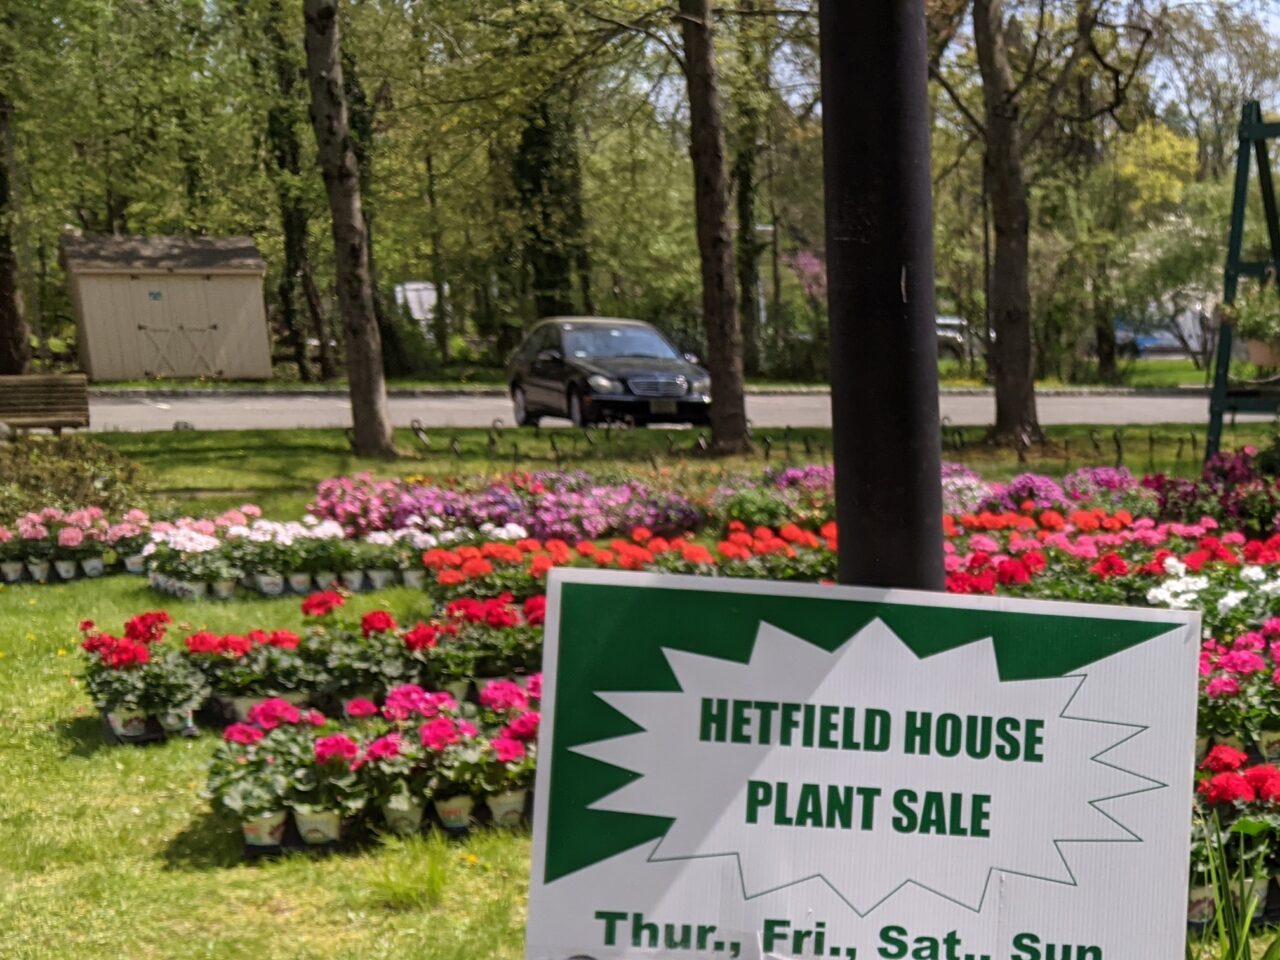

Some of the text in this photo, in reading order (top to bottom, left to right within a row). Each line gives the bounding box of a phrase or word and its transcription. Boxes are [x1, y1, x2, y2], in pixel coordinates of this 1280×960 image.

[700, 698, 1044, 762] HETFIELD HOUSE
[746, 781, 990, 837] PLANT SALE
[589, 911, 740, 960] Thur.,
